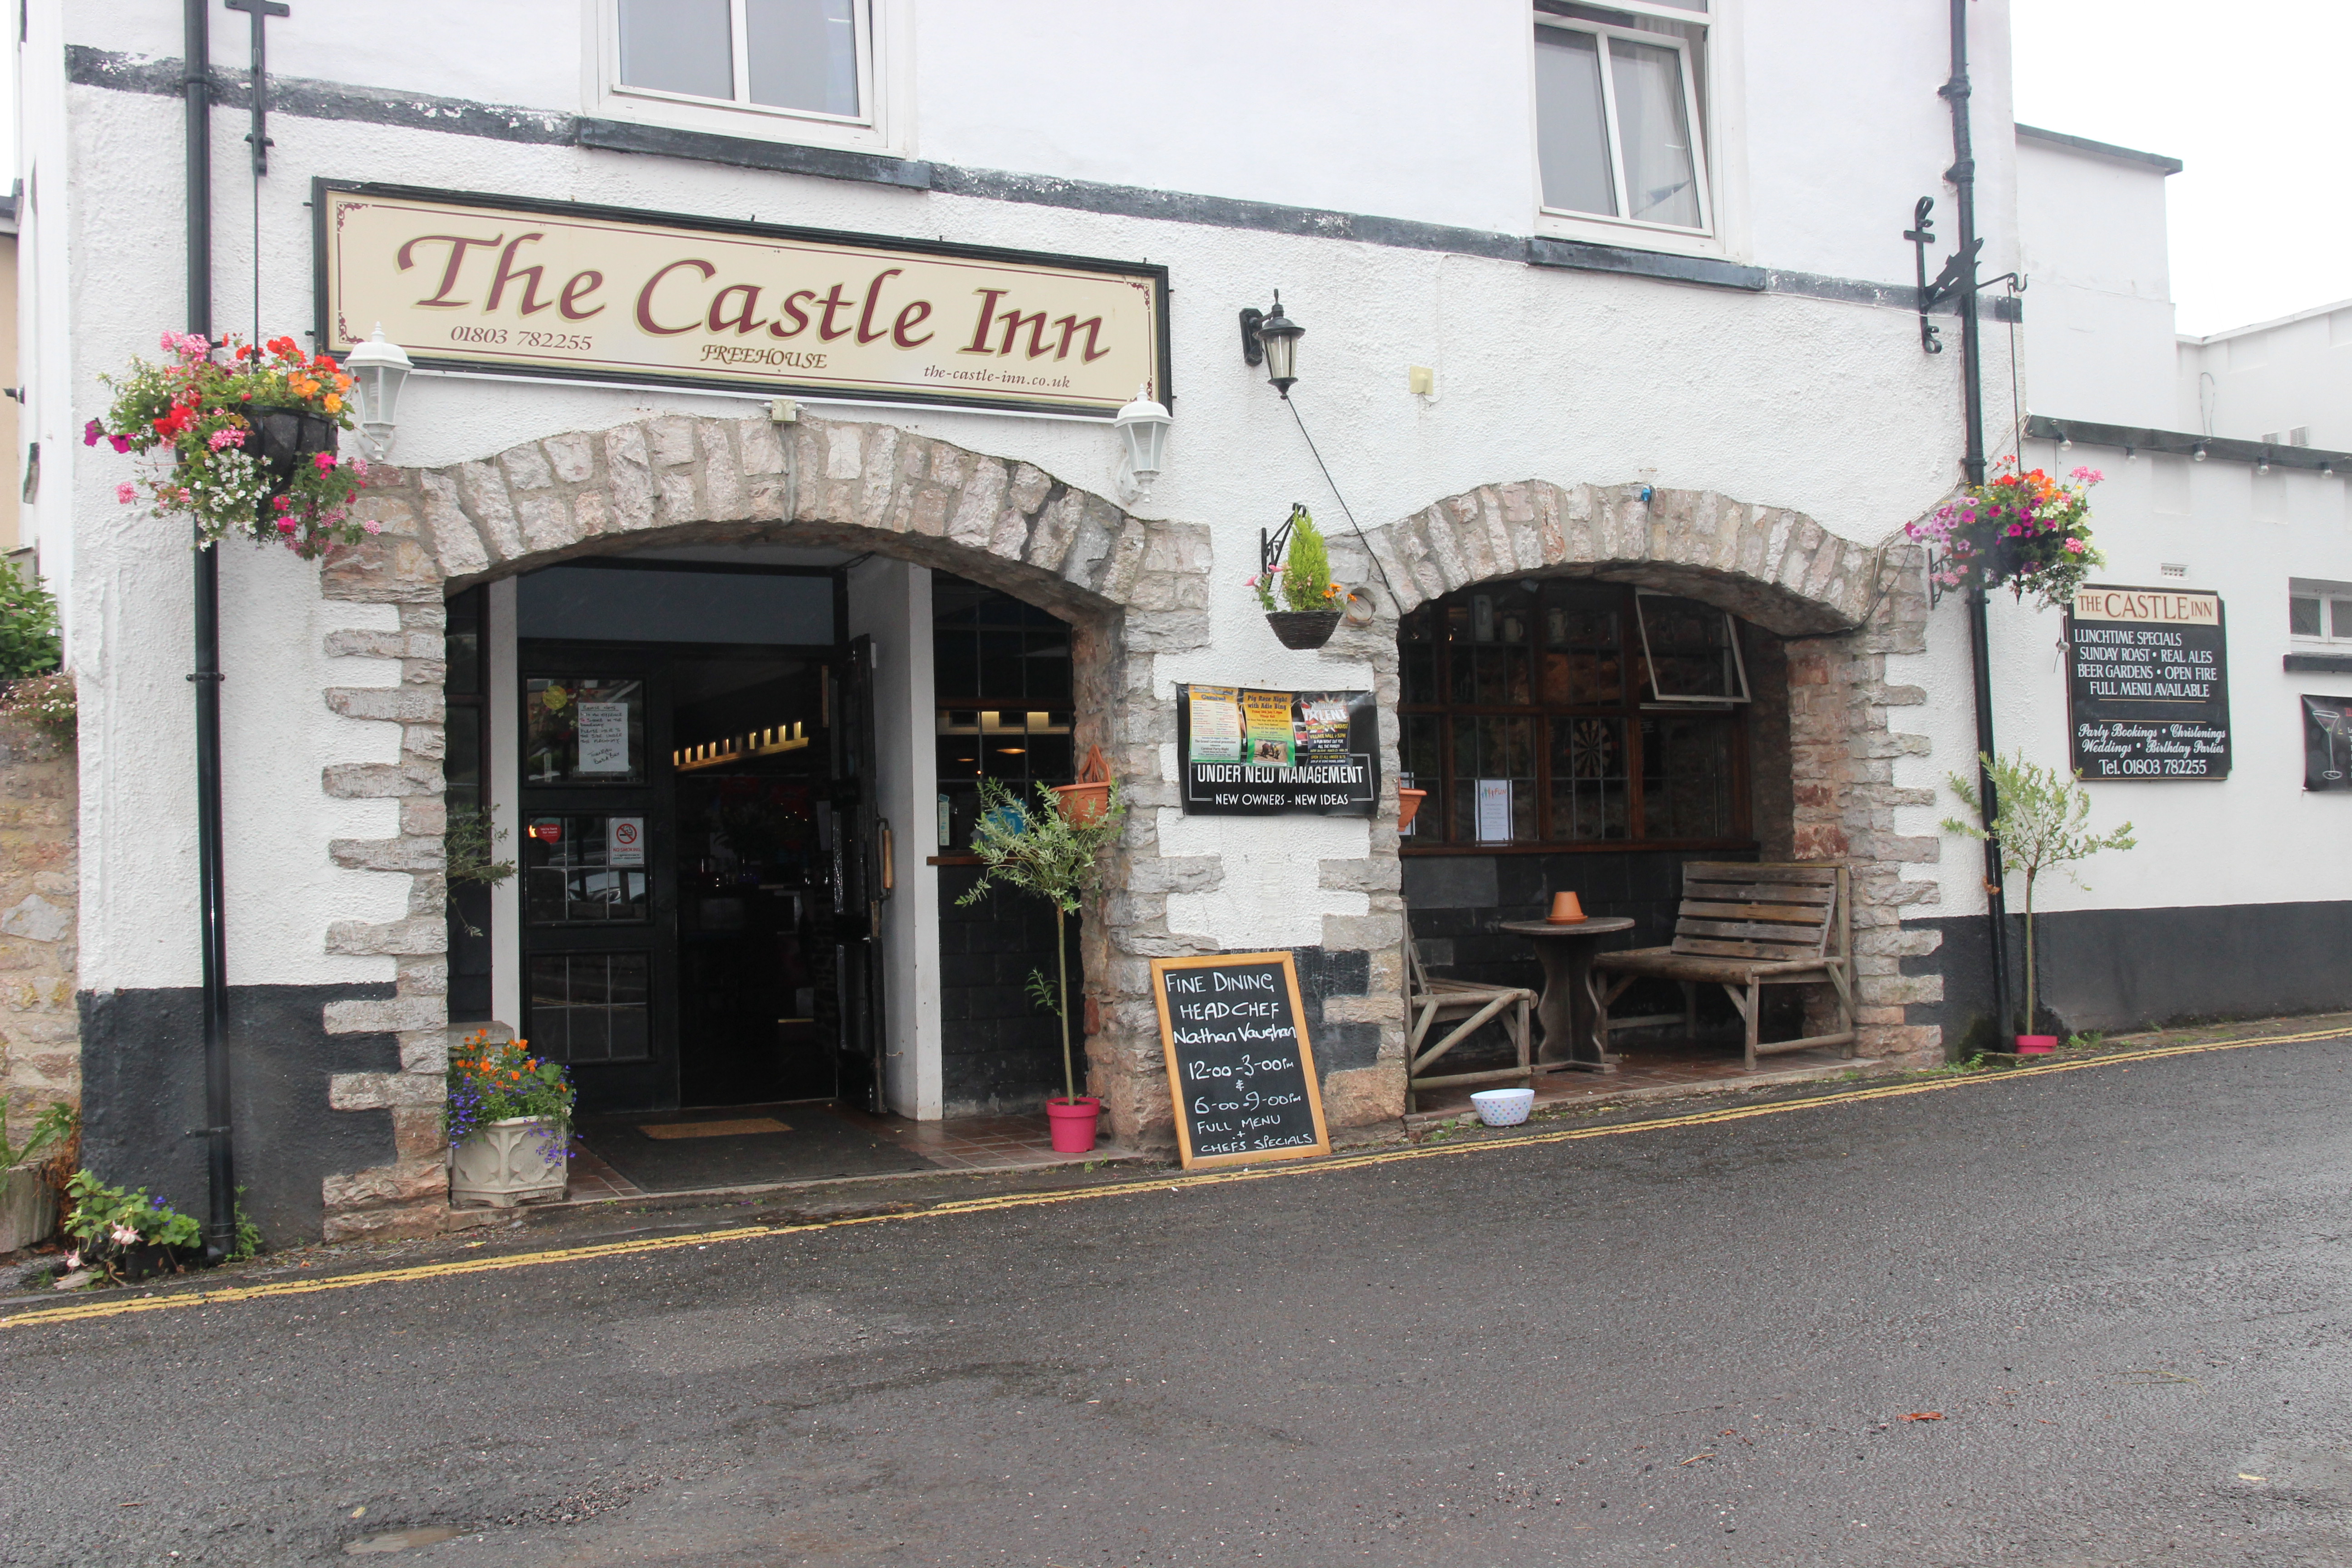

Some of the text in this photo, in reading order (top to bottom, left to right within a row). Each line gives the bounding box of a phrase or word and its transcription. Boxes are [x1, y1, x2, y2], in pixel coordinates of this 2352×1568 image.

[395, 230, 1111, 365] The Castle Inn
[451, 325, 593, 351] 01803 782255
[701, 344, 827, 369] FREEHOUSE
[924, 364, 1070, 389] the-castle-inn.co.uk
[2078, 593, 2212, 620] THE CASTLE INN
[2074, 628, 2182, 647] LUNCHTIME SPECIALS
[2080, 647, 2213, 664] SUNDAY ROAST REAL ALES
[2078, 663, 2217, 681] BEER GARDENS OPEN FIRE
[2090, 681, 2210, 697] FULL MENU AVAILABLE
[1303, 706, 1348, 721] TALENT
[2078, 724, 2225, 743] Party Bookings Christenings
[2082, 739, 2224, 759] Weddings Birthday Parties
[1197, 764, 1363, 784] UNDER NEW MANAGEMENT
[2098, 759, 2206, 775] Tel. 01803 782255
[1215, 794, 1239, 805] NEW
[1242, 794, 1284, 806] OWNERS
[1295, 794, 1317, 805] NEW
[1321, 794, 1348, 805] IDEAS
[1166, 972, 1275, 994] FINE DINING
[1173, 1022, 1297, 1044] Nathan Vaughan
[1197, 1114, 1280, 1134] FULL MENU
[1200, 1133, 1312, 1153] CHEFS SPECIALS
